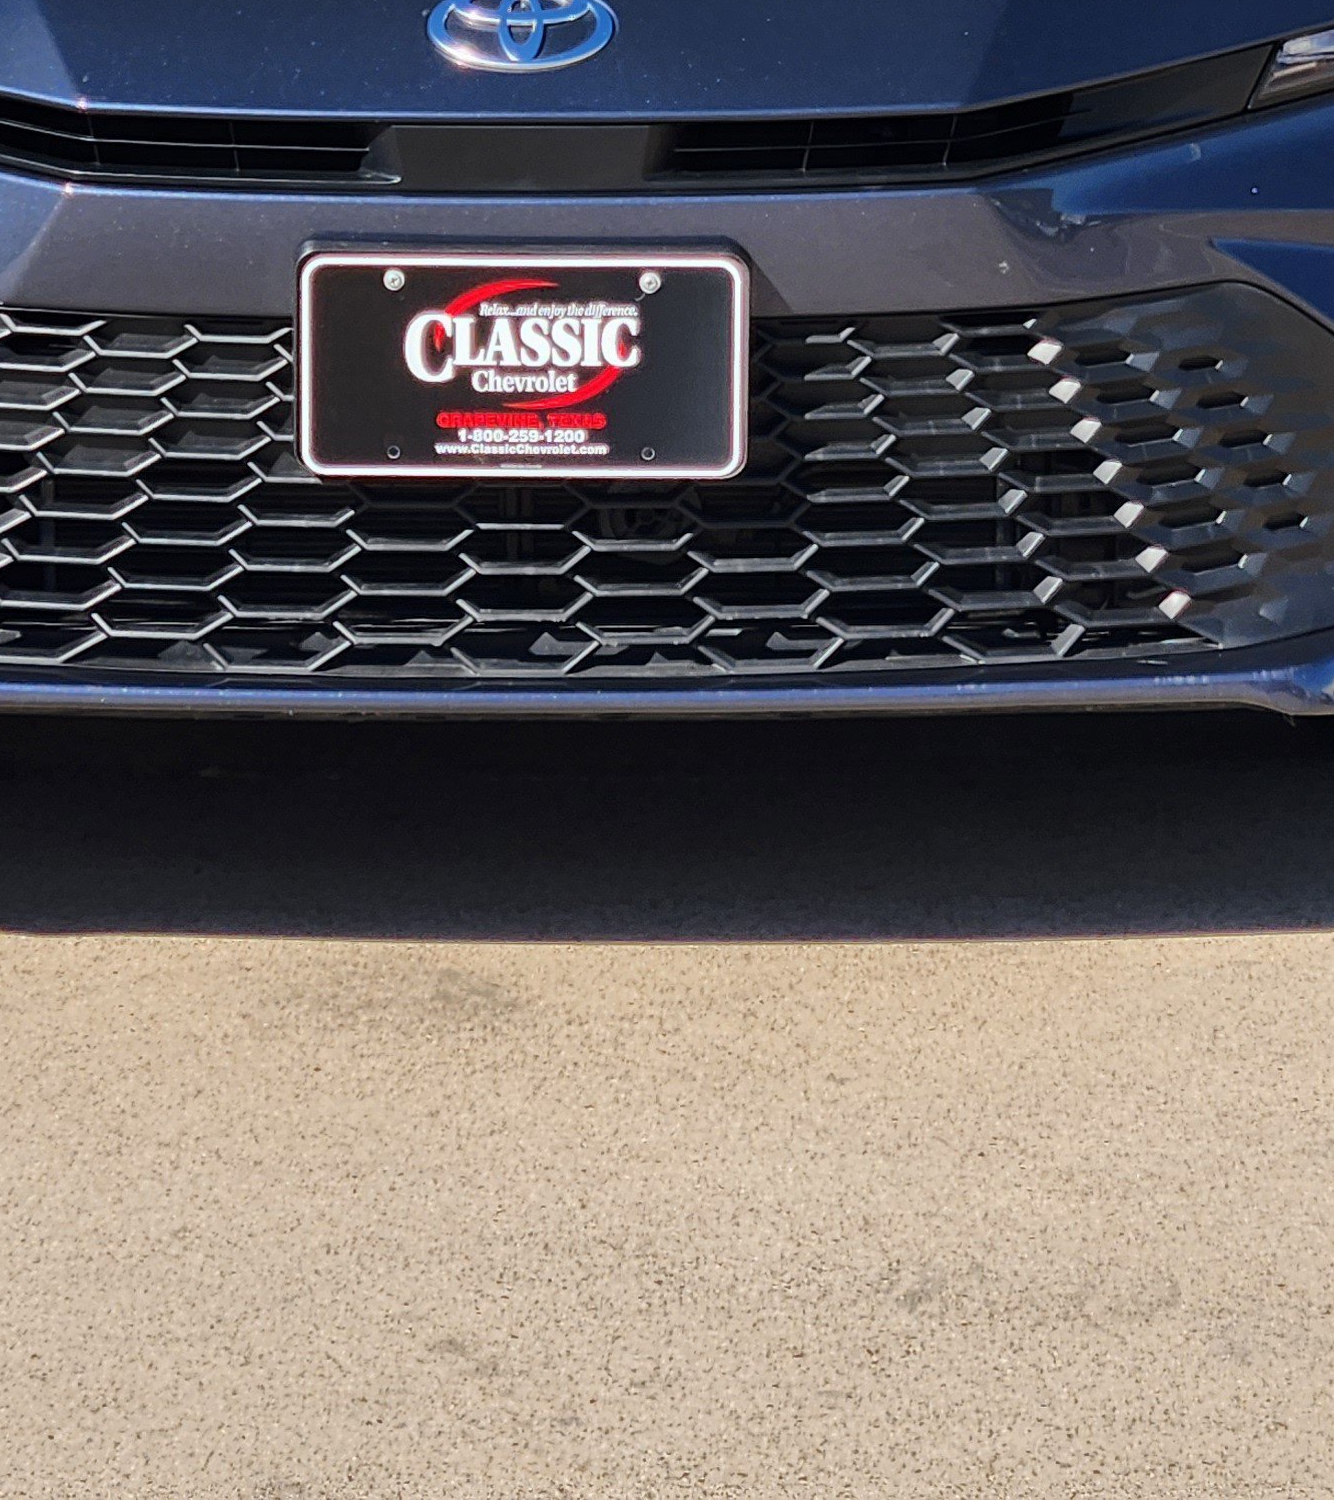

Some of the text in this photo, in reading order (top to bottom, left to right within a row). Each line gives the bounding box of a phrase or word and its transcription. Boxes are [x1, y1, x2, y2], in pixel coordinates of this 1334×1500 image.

[538, 305, 567, 319] enjoy
[567, 302, 584, 317] the
[405, 311, 641, 383] CLASSIC
[470, 369, 578, 393] Chevrolet
[436, 411, 607, 429] GRAPEVINE, TEXAS
[457, 428, 586, 443] 1-800-259-1200
[434, 443, 609, 455] www.ClassicChevrolet.com
